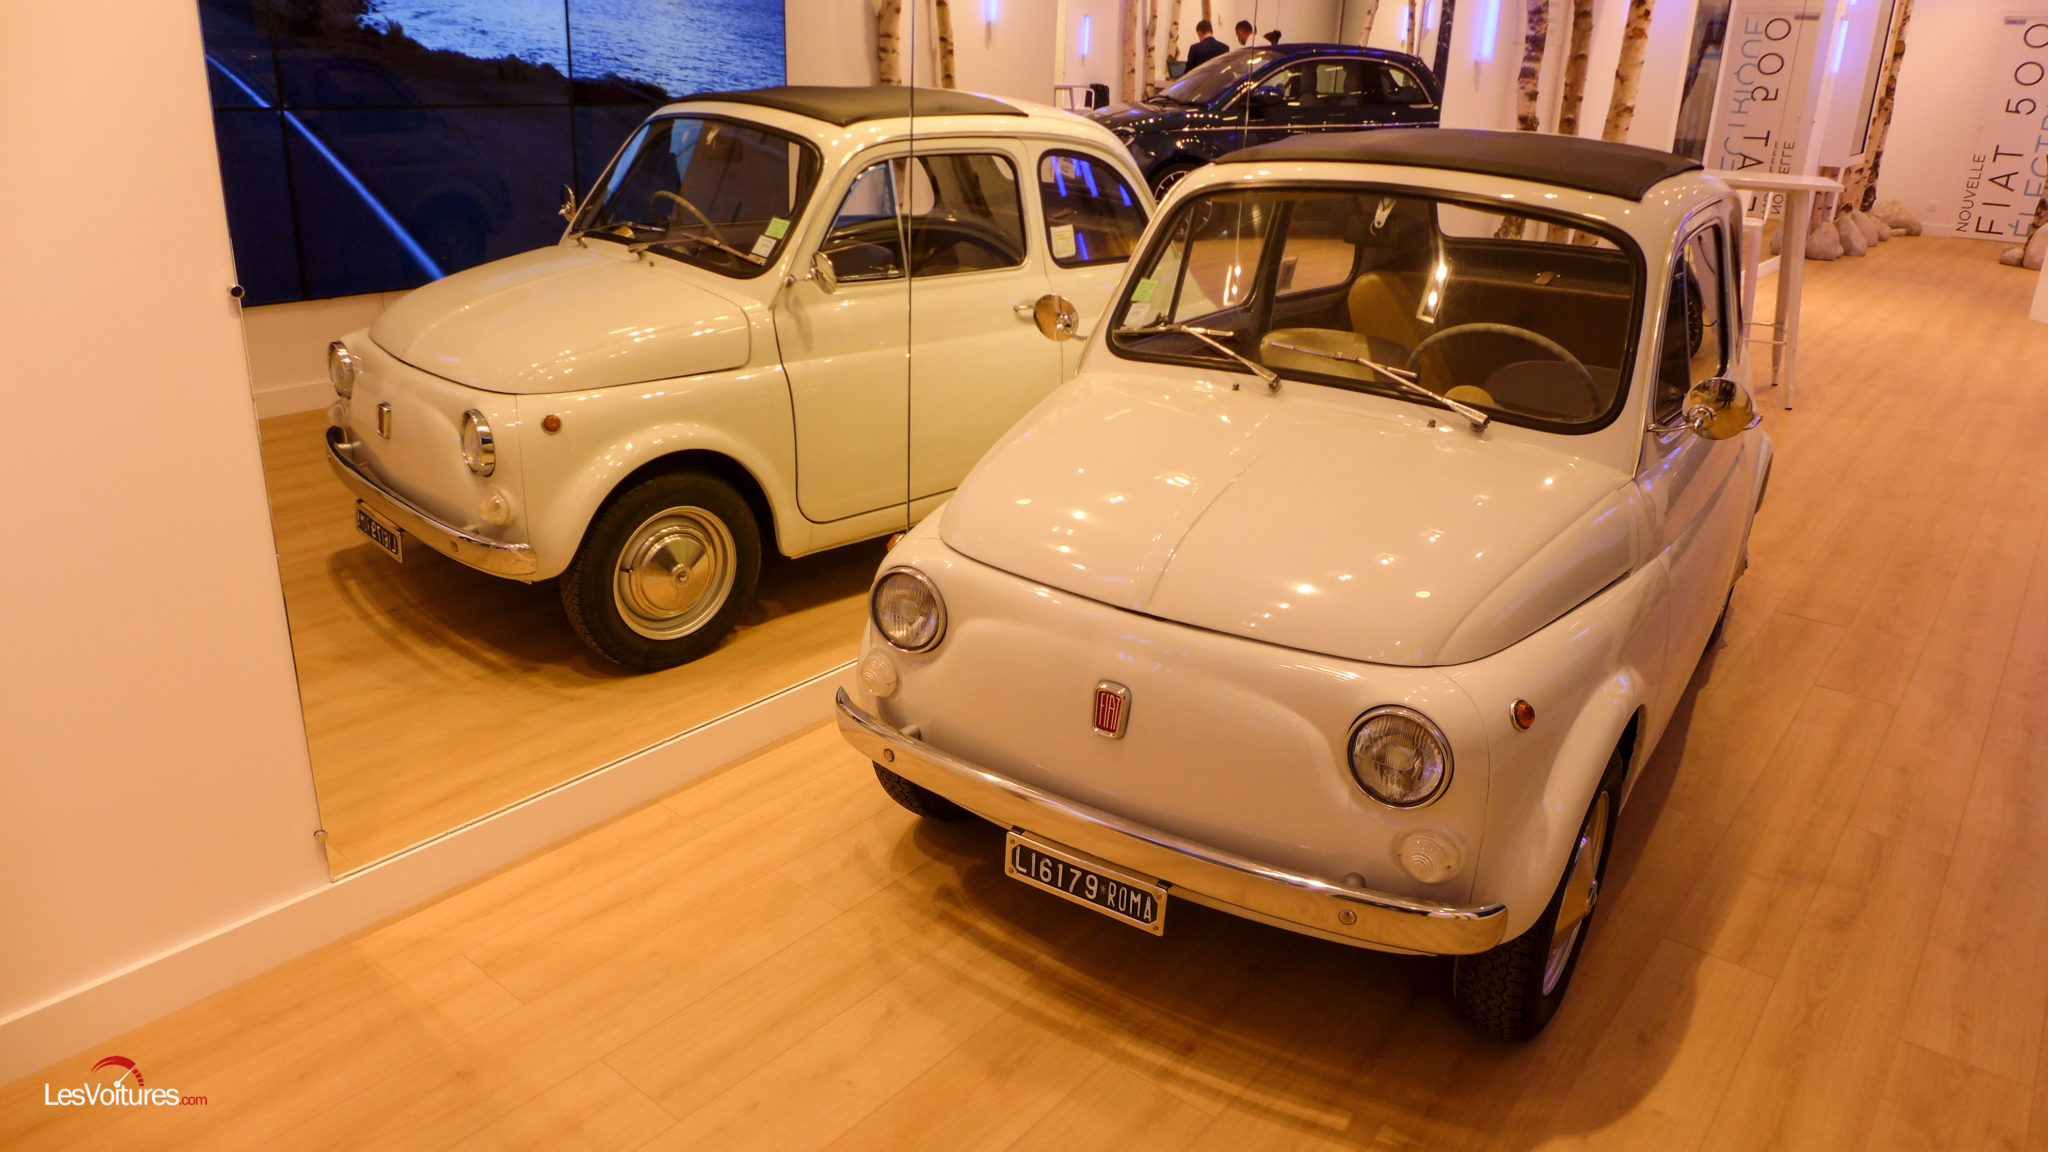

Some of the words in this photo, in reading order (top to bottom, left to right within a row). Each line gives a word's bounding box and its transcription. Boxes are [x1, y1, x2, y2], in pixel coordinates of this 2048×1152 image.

[1974, 144, 2024, 235] FIAT
[2005, 23, 2048, 115] 500
[1955, 154, 1986, 232] NOUVELLE
[1098, 692, 1121, 731] FIAT
[1015, 845, 1099, 900] L16179
[1107, 881, 1152, 922] ROMA
